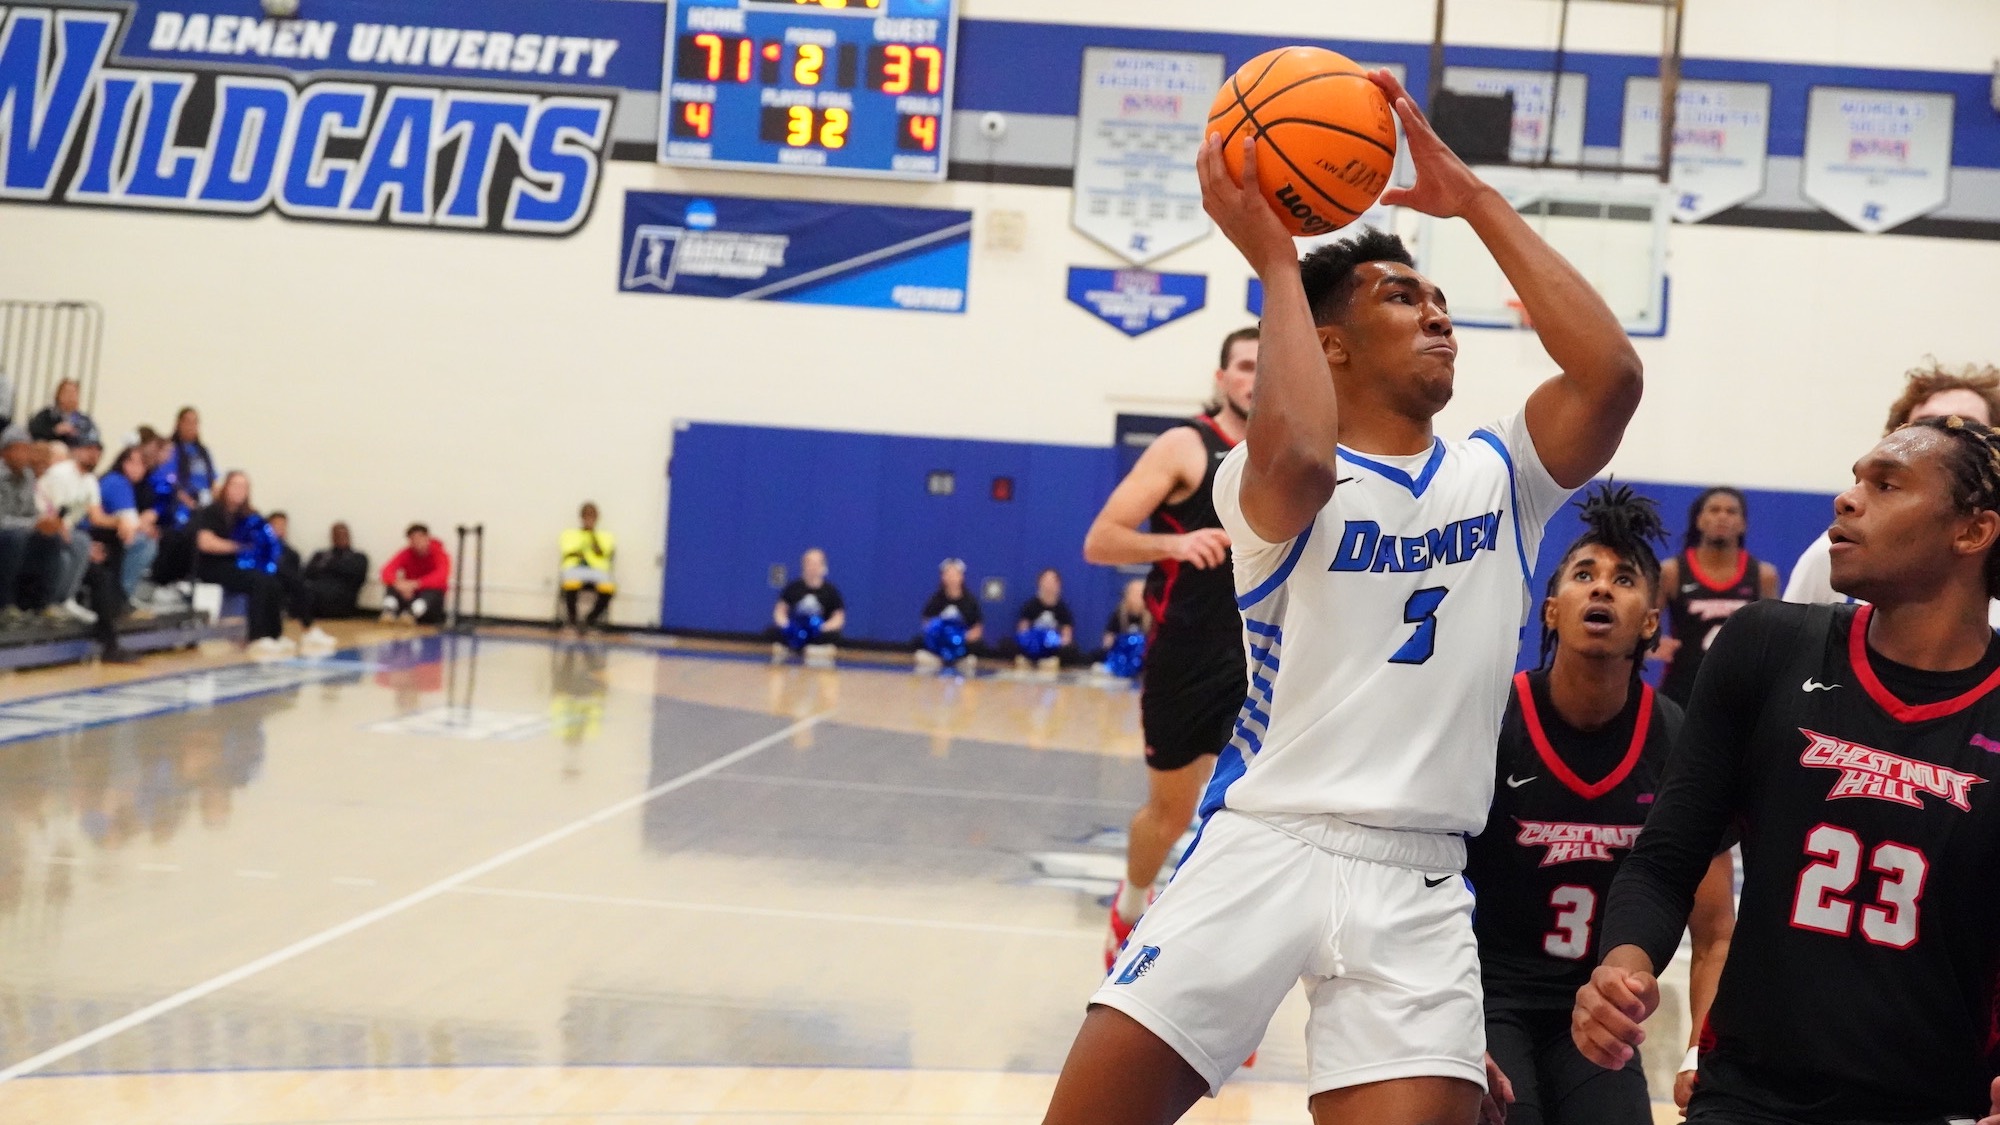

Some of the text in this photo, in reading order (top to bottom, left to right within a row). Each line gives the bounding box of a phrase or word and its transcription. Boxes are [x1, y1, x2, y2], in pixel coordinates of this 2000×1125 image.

[150, 11, 620, 78] DAEMEN UNIVERSITY
[695, 34, 753, 81] 71
[794, 44, 824, 86] 2
[882, 44, 942, 94] 37
[684, 102, 712, 138] 4
[786, 105, 849, 148] 32
[910, 115, 936, 151] 4
[1328, 510, 1503, 572] DAEMEN
[1387, 585, 1449, 665] 3
[1798, 727, 1989, 812] CHESTNUT
[1789, 822, 1929, 949] 23
[1542, 883, 1597, 961] 3
